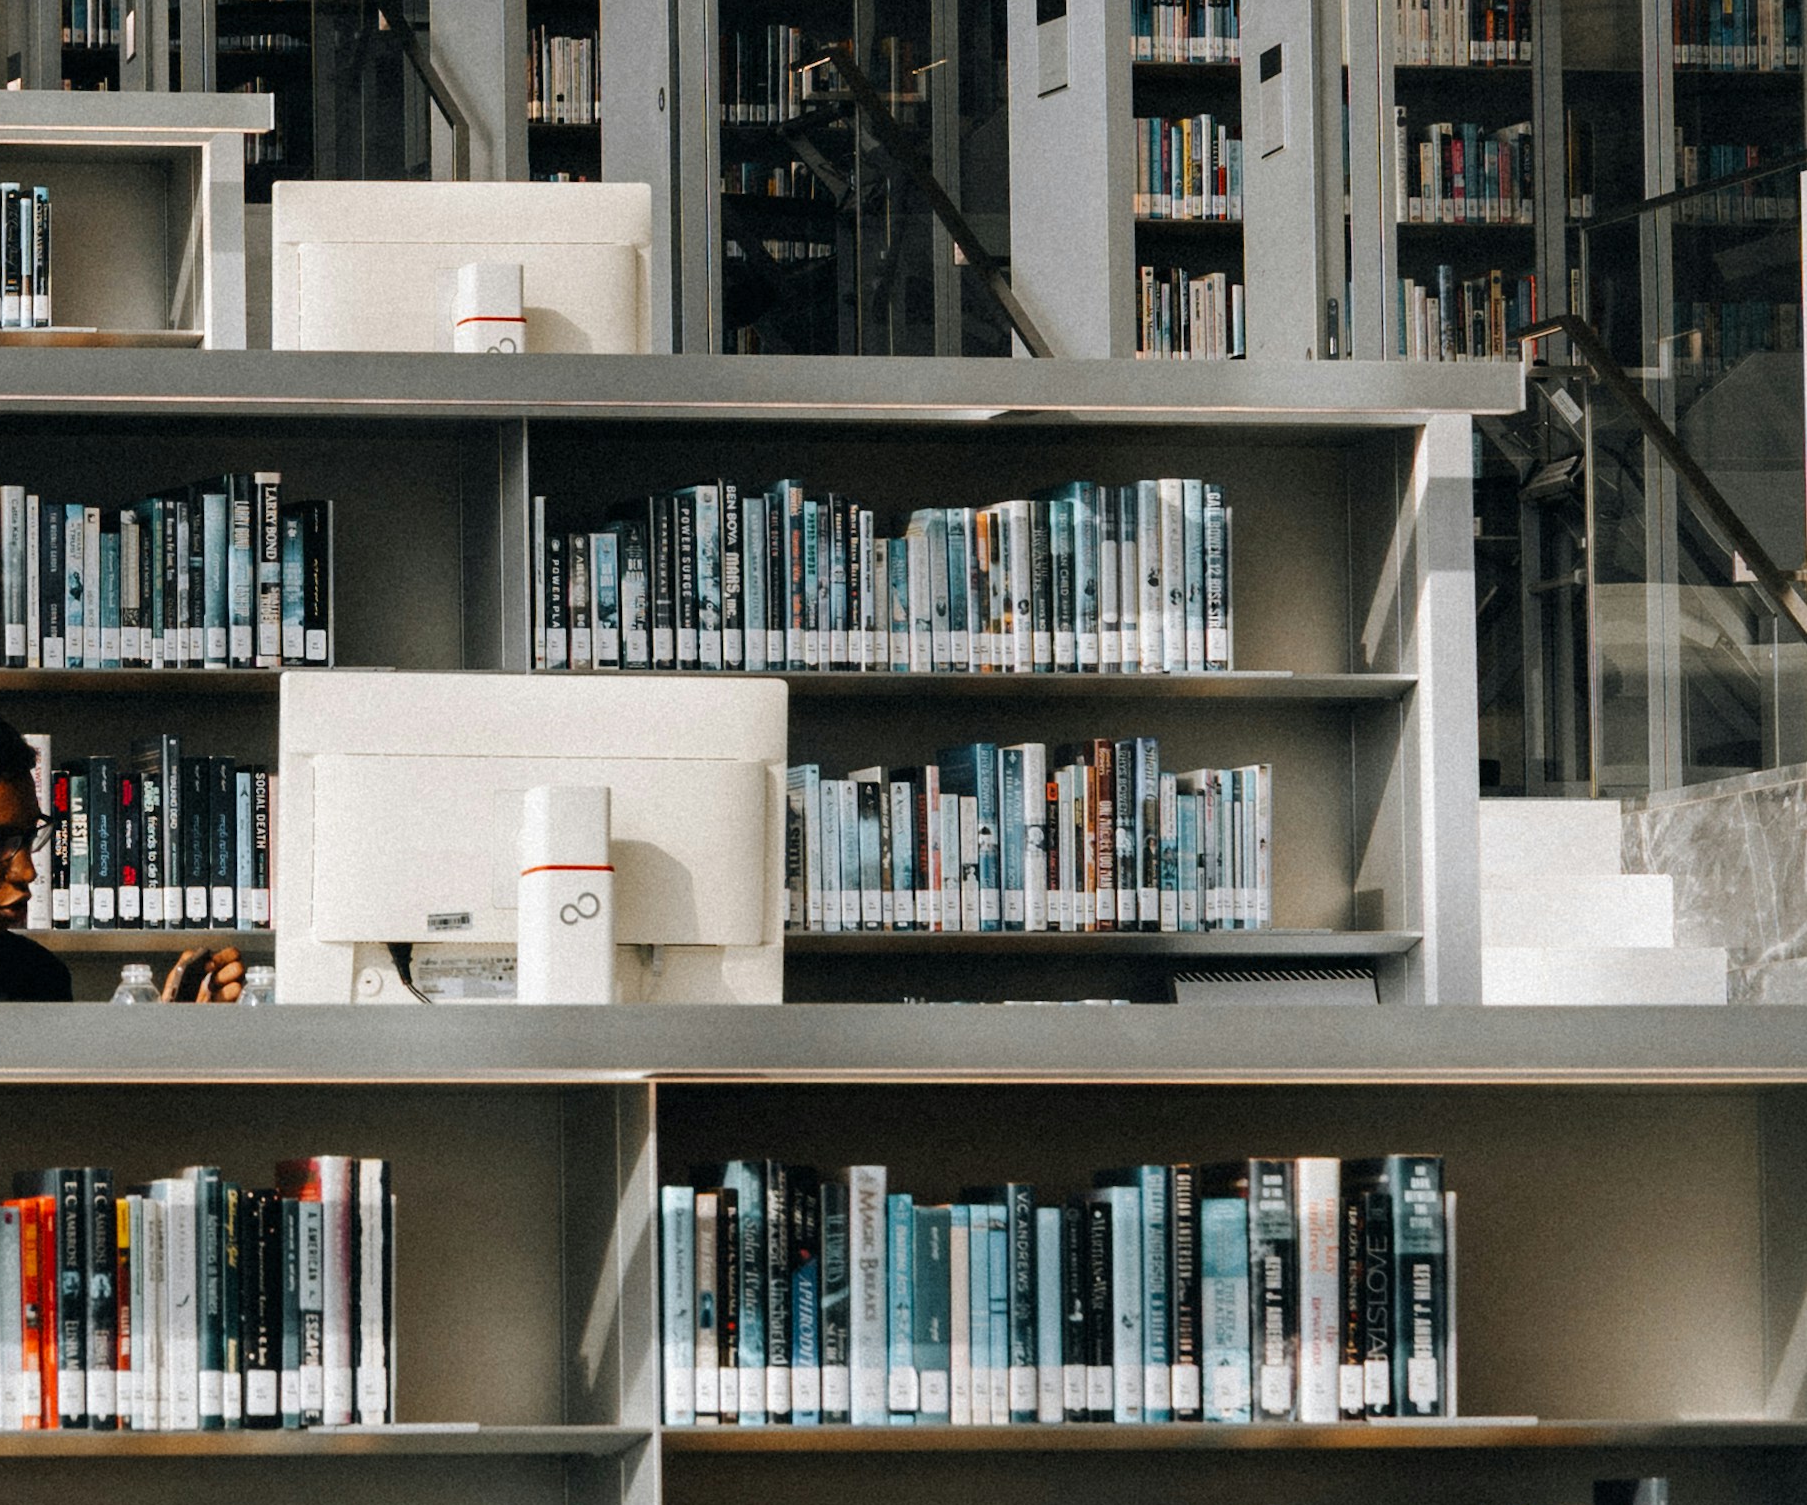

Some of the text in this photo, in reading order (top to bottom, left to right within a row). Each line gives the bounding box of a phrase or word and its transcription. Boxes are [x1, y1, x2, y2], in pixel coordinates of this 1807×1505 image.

[265, 487, 278, 560] LARRY BOND
[726, 486, 736, 510] BEN
[727, 513, 736, 546] BOVA
[551, 559, 560, 601] POWER
[681, 508, 692, 597] POWER SURGE
[1207, 492, 1222, 606] GAIL BOWEN 12 ROSE
[1119, 750, 1127, 775] RHYS
[71, 814, 87, 856] BESTIA
[255, 772, 266, 849] SOCIAL DEATH
[147, 816, 158, 880] friends to die
[308, 1227, 317, 1281] AMERICAN
[744, 1218, 758, 1263] Stolen
[859, 1189, 878, 1321] MAGIC BREAKS
[1017, 1220, 1029, 1293] ANDREWS
[1176, 1174, 1192, 1278] GILLIAN ANDERSON
[1265, 1256, 1282, 1289] KEVIN
[1413, 1264, 1430, 1300] KEVIN
[770, 1279, 789, 1365] Uncharted
[798, 1276, 813, 1365] APHRODIT
